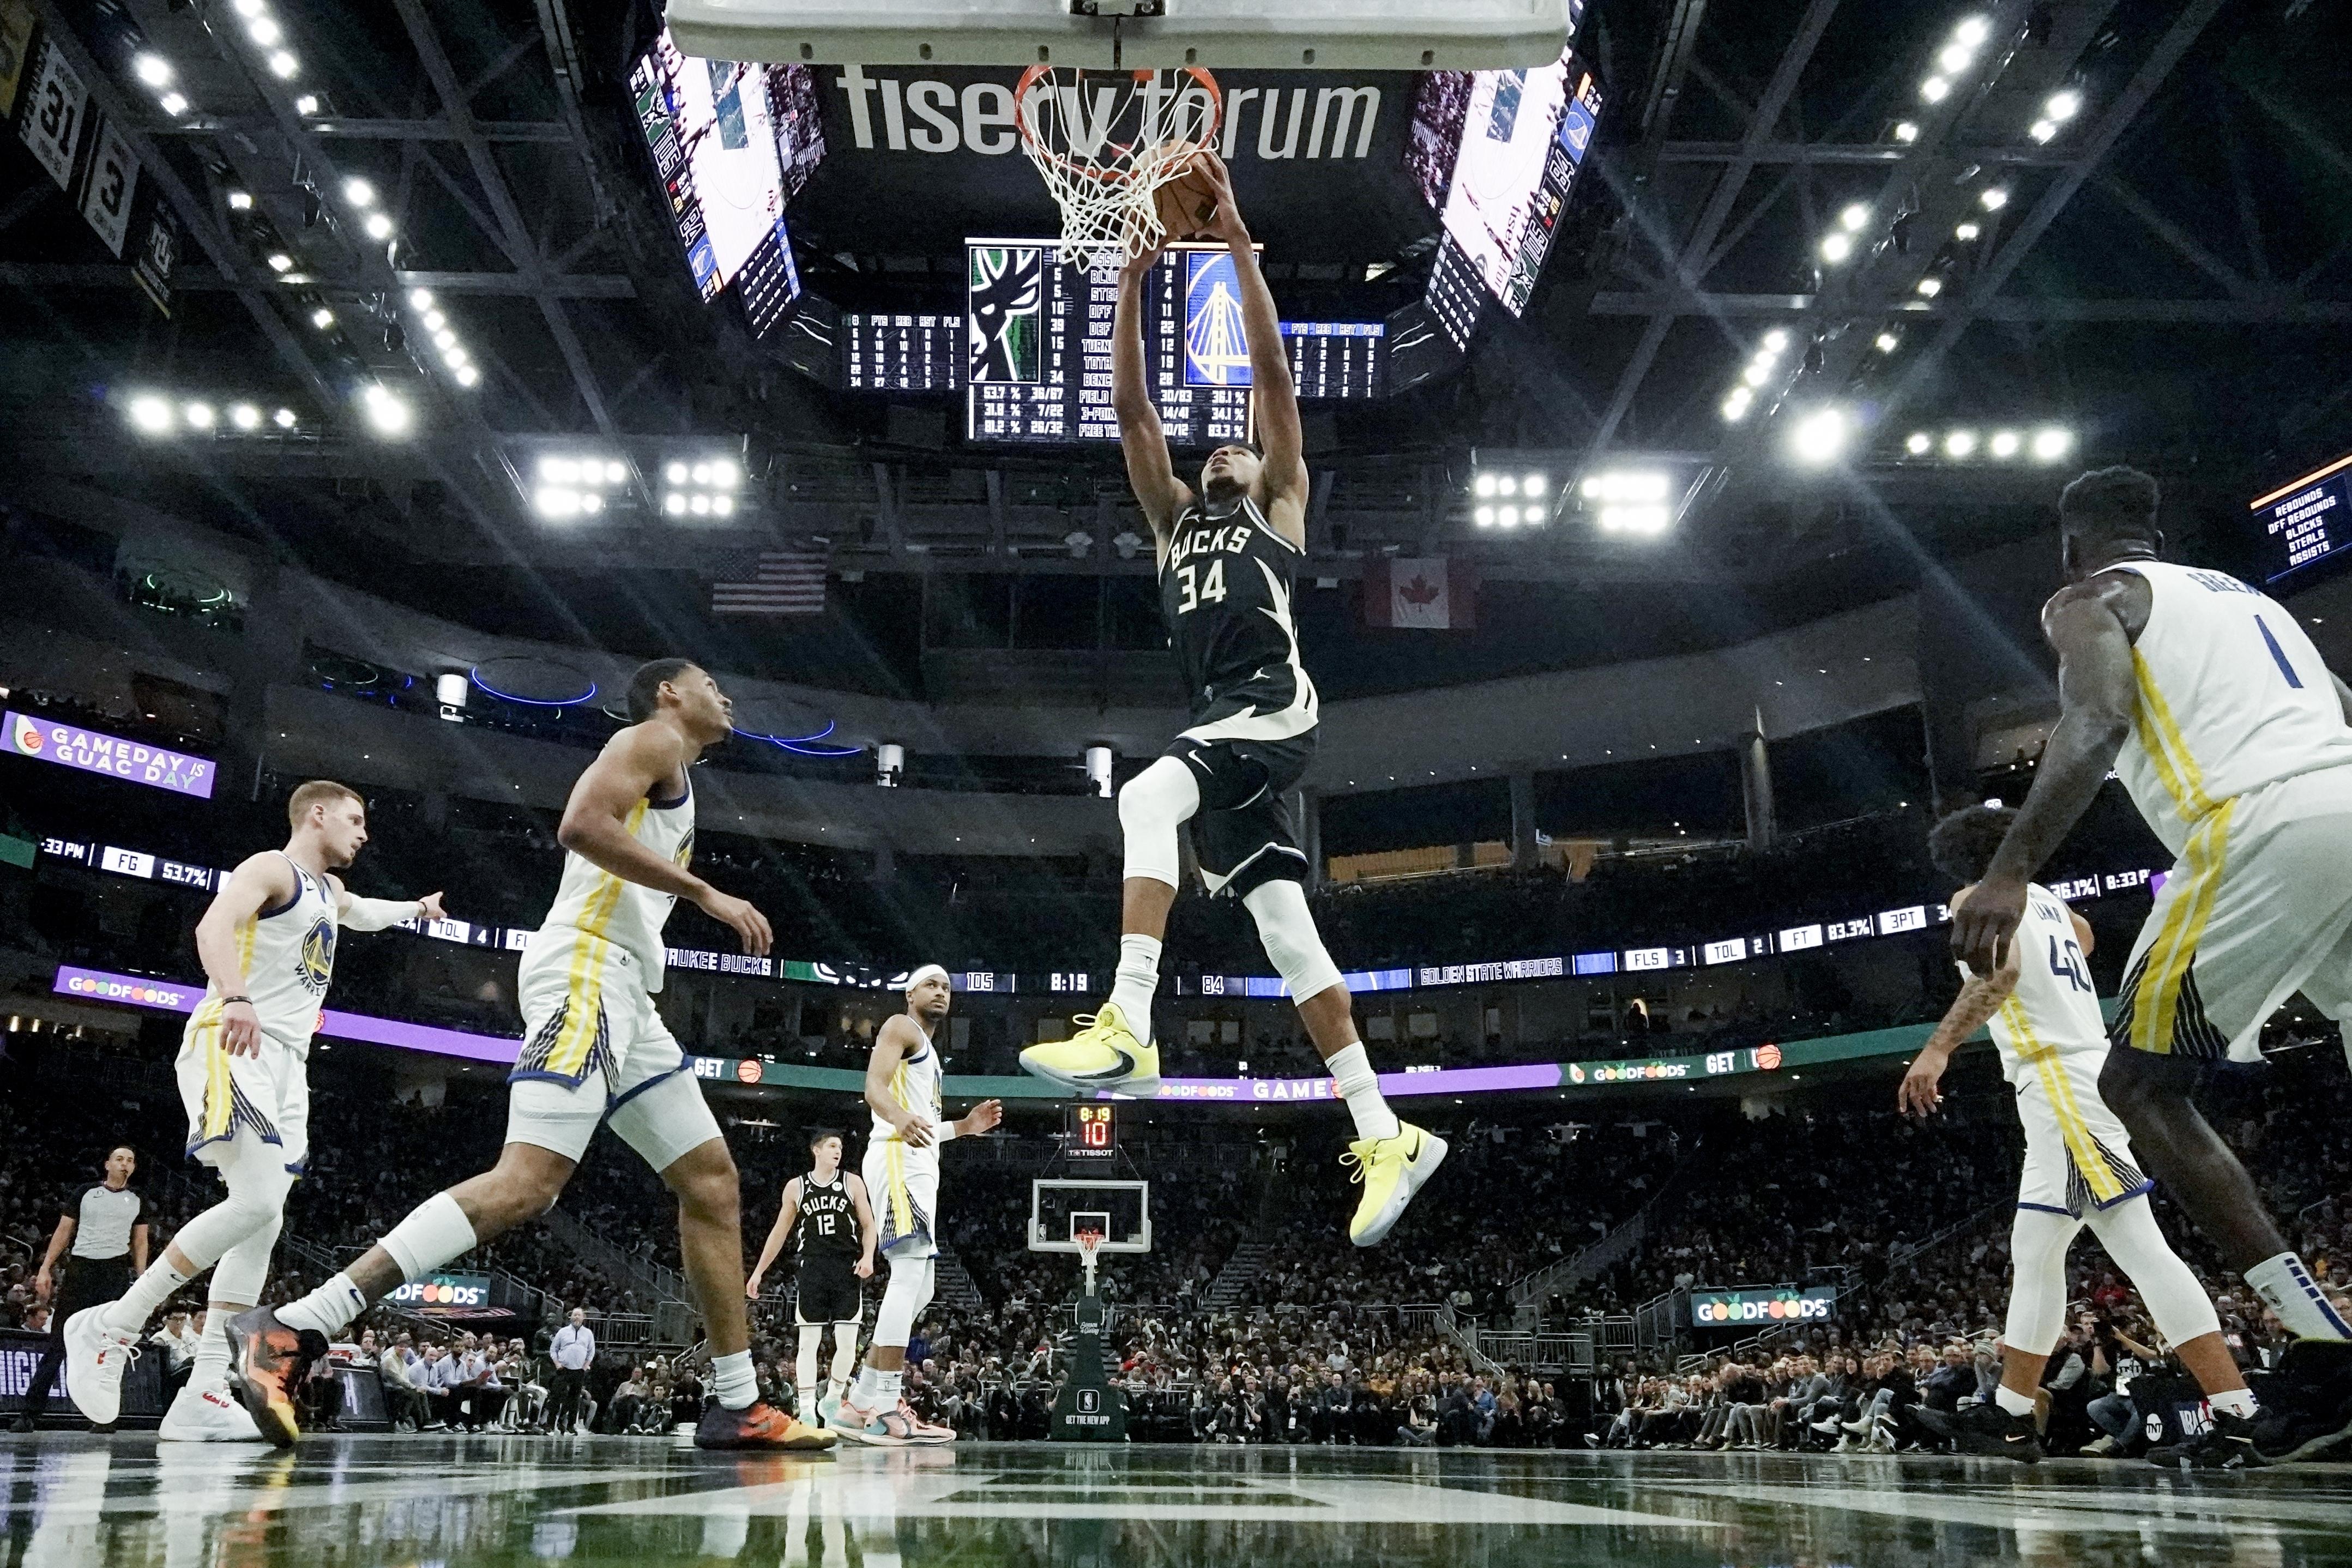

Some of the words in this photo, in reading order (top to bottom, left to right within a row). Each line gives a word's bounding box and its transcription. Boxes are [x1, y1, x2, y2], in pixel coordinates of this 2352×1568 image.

[1136, 69, 1380, 159] forum
[654, 126, 681, 178] 105
[1549, 149, 1575, 193] 84
[680, 206, 703, 247] 84
[1522, 219, 1548, 266] 105
[1163, 251, 1177, 266] 19
[1054, 267, 1062, 281] 5
[1090, 270, 1119, 285] BLOC
[1165, 269, 1173, 284] 2
[1054, 284, 1062, 298] 5
[1090, 287, 1118, 301] STEA
[1164, 286, 1172, 300] 4
[1052, 301, 1065, 315] 10
[1088, 304, 1112, 319] OFF
[1162, 303, 1172, 317] 11
[871, 315, 888, 326] PTS
[895, 316, 912, 327] REB
[919, 316, 936, 327] AST
[1050, 318, 1064, 332] 39
[1088, 321, 1112, 336] DEF
[1160, 320, 1175, 334] 22
[1292, 323, 1308, 334] PTS
[1316, 323, 1332, 335] REB
[1339, 324, 1356, 335] AST
[852, 328, 859, 338] 5
[876, 328, 883, 339] 4
[900, 329, 907, 339] 4
[925, 329, 931, 340] 0
[950, 329, 954, 340] 1
[1051, 336, 1064, 350] 15
[1161, 338, 1174, 352] 12
[1320, 337, 1327, 348] 5
[875, 340, 884, 351] 18
[899, 341, 908, 351] 10
[925, 341, 931, 352] 0
[950, 341, 954, 352] 1
[1295, 348, 1302, 359] 3
[1320, 349, 1327, 360] 2
[851, 352, 860, 363] 12
[900, 353, 907, 364] 4
[925, 353, 931, 364] 2
[950, 354, 954, 364] 1
[1053, 353, 1061, 366] 9
[1083, 355, 1112, 370] TOTA
[1161, 355, 1174, 369] 19
[1294, 361, 1303, 372] 15
[1319, 361, 1326, 372] 2
[851, 364, 861, 375] 22
[875, 364, 884, 375] 17
[901, 365, 907, 375] 4
[925, 365, 931, 376] 2
[950, 366, 954, 376] 1
[1050, 370, 1064, 384] 34
[1083, 373, 1113, 387] BENC
[1159, 372, 1174, 386] 28
[1295, 373, 1301, 384] 0
[1319, 373, 1326, 384] 0
[850, 376, 861, 387] 34
[875, 377, 885, 388] 27
[900, 377, 909, 389] 12
[925, 378, 931, 388] 5
[949, 378, 955, 389] 3
[1318, 385, 1325, 397] 2
[984, 385, 1005, 400] 53.7
[1030, 387, 1064, 402] 36/67
[1078, 390, 1109, 403] FIELD
[1160, 389, 1192, 403] 30/83
[1211, 390, 1232, 404] 36.1
[984, 402, 1004, 417] 31.8
[1038, 403, 1064, 417] 7/22
[1081, 407, 1117, 421] 3-POIN
[1163, 406, 1190, 420] 14/41
[1211, 407, 1232, 420] 34.1
[984, 419, 1005, 434] 81.2
[1030, 420, 1063, 434] 26/32
[1078, 424, 1102, 437] FREE
[1208, 424, 1231, 437] 83.3
[2275, 487, 2324, 518] REBOUNDS
[2267, 518, 2287, 535] OFF
[2287, 495, 2336, 526] REBOUNDS
[2285, 516, 2323, 540] BLOCKS
[1171, 526, 1252, 571] BUCKS
[2289, 529, 2325, 553] STEALS
[2289, 541, 2331, 566] ASSISTS
[1177, 559, 1227, 614] 34
[2253, 614, 2305, 689] 1
[51, 728, 184, 773] GAMEDAY
[190, 763, 206, 777] IS
[56, 745, 132, 775] GUAC
[145, 765, 196, 790] DAY
[64, 842, 85, 859] PM
[118, 853, 138, 871] FG
[162, 863, 207, 886] 53.7%
[2050, 878, 2096, 899] 36.1%
[2106, 871, 2138, 890] 8:33
[439, 920, 460, 938] TOL
[477, 929, 487, 944] 4
[1635, 952, 1659, 966] FLS
[1675, 950, 1685, 964] 3
[1714, 944, 1738, 960] TOL
[1753, 938, 1763, 954] 2
[1793, 930, 1808, 946] FT
[1828, 918, 1870, 940] 83.3%
[1890, 911, 1915, 928] 3PT
[664, 947, 718, 970] AUKEE
[720, 954, 772, 976] BUCKS
[1420, 966, 1466, 986] GOLDEN
[1466, 962, 1503, 982] STATE
[1503, 957, 1563, 979] WARRIORS
[2049, 935, 2092, 993] 40
[966, 972, 994, 991] 105
[1051, 973, 1087, 992] 8:19
[1202, 975, 1225, 994] 84
[693, 1059, 724, 1078] GET
[1706, 1053, 1735, 1074] GET
[1253, 1079, 1332, 1099] GAME
[1080, 1107, 1110, 1121] 8:19
[1084, 1122, 1106, 1145] 10
[802, 1196, 847, 1216] BUCKS
[817, 1214, 836, 1235] 12
[1066, 1415, 1076, 1425] GET
[1076, 1415, 1087, 1425] THE
[1087, 1415, 1099, 1425] NEW
[1099, 1415, 1110, 1425] APP
[2146, 1422, 2163, 1433] TNT
